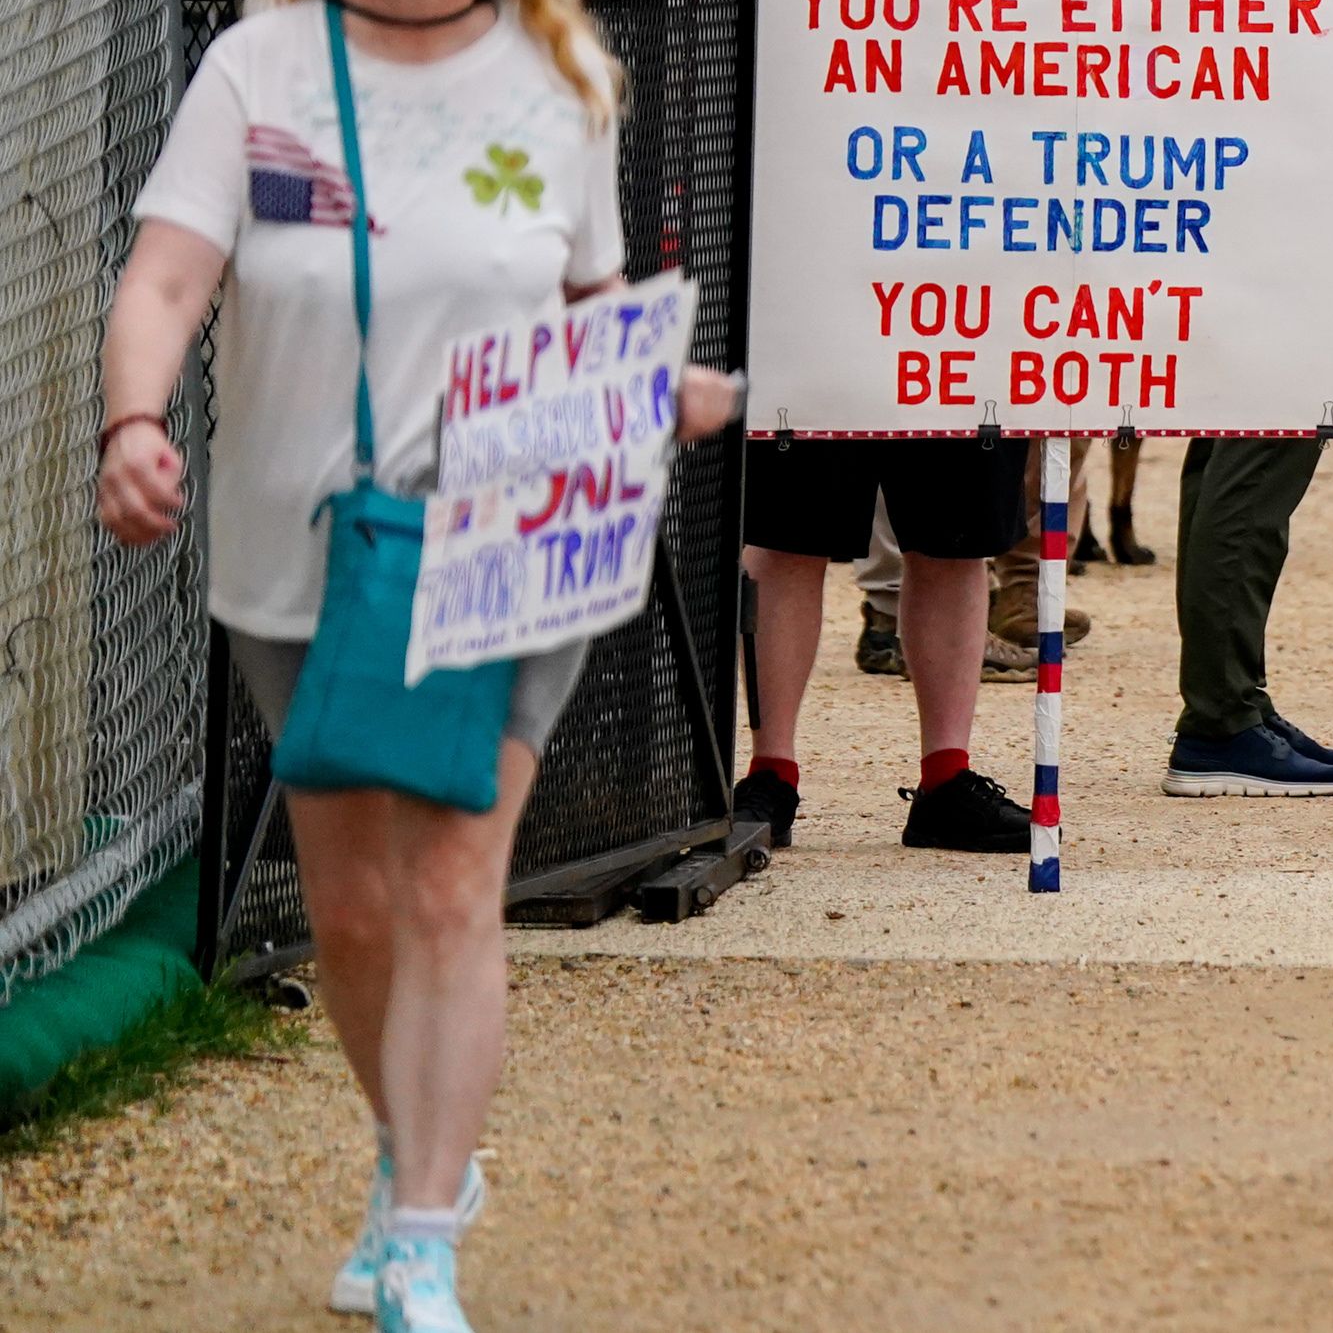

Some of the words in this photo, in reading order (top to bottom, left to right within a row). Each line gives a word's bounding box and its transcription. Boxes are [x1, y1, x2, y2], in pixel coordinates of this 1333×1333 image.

[824, 39, 902, 93] AN
[937, 41, 1269, 101] AMERICAN
[848, 126, 926, 181] OR
[962, 130, 993, 184] A
[1032, 132, 1248, 191] TRUMP
[873, 195, 1211, 254] DEFENDER
[872, 282, 991, 339] YOU
[1023, 279, 1203, 342] CAN'T
[446, 322, 553, 422] HELP
[897, 351, 976, 406] BE
[1009, 351, 1178, 408] BOTH
